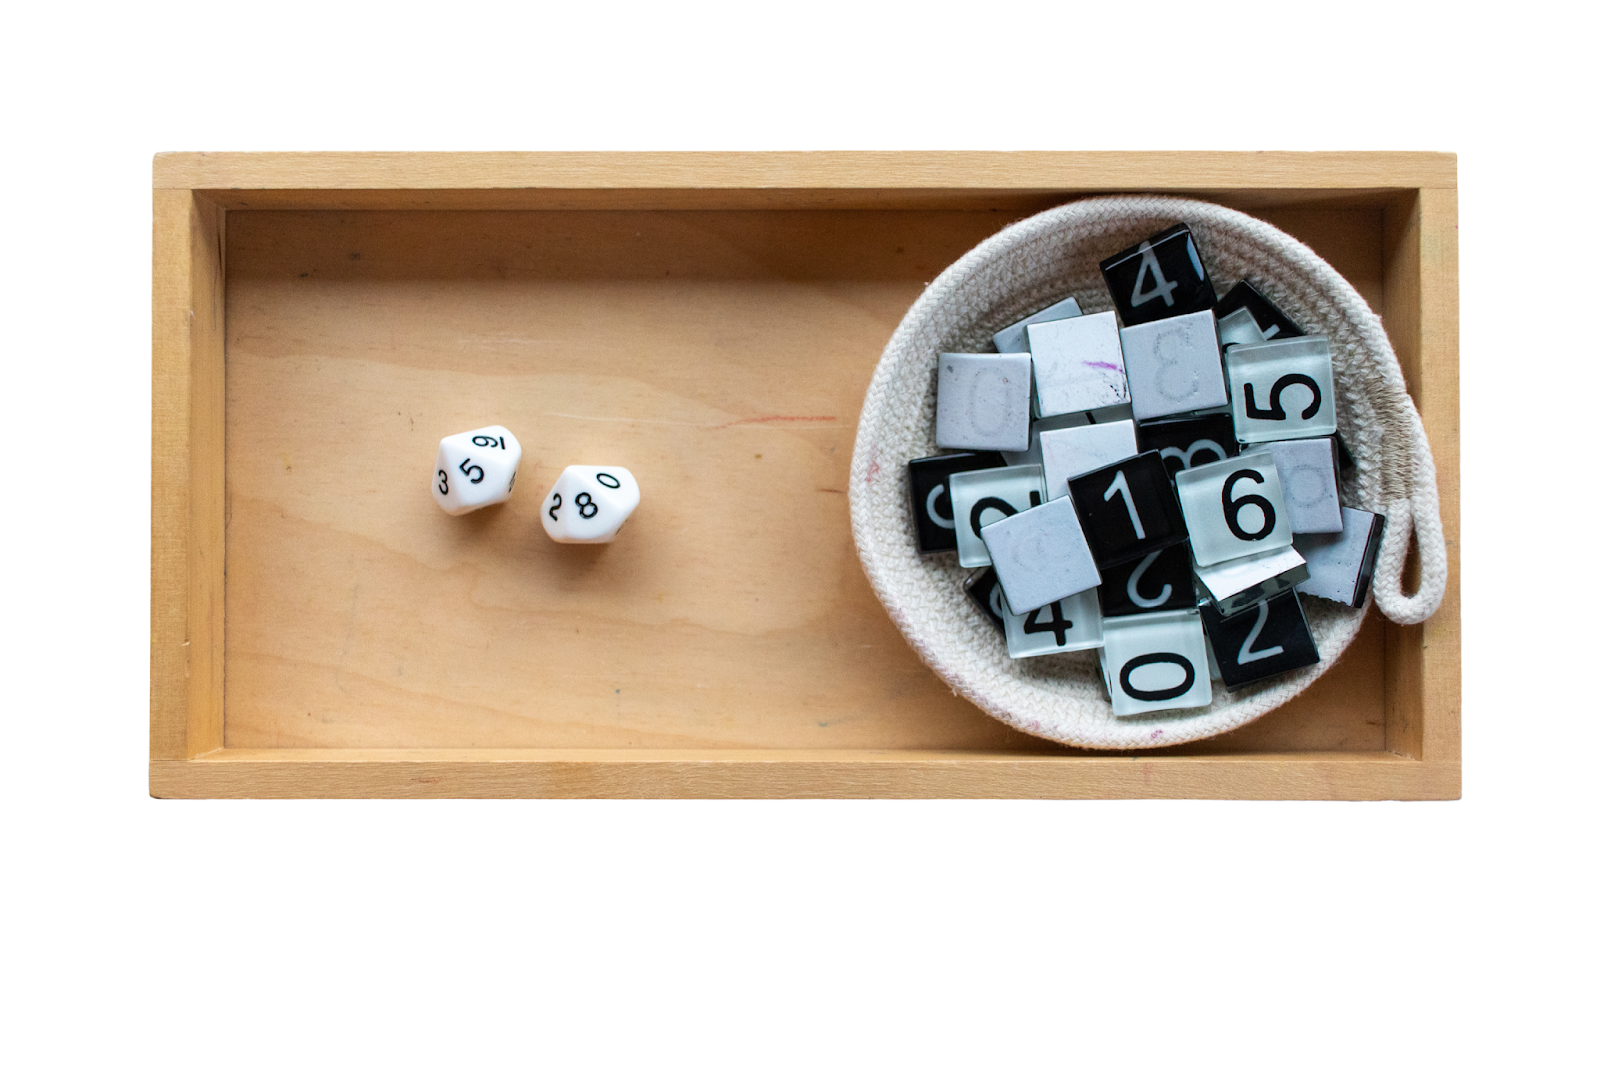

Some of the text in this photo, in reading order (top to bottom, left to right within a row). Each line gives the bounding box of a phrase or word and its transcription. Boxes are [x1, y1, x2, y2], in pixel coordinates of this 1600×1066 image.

[1131, 240, 1178, 307] 4
[1244, 373, 1322, 421] 5
[438, 469, 449, 496] 3
[459, 458, 485, 484] 5
[596, 472, 621, 489] 0
[549, 493, 562, 521] 2
[575, 492, 598, 519] 8
[1103, 470, 1146, 540] 1
[1221, 468, 1277, 542] 6
[1023, 600, 1073, 647] 4
[1119, 652, 1196, 701] 0
